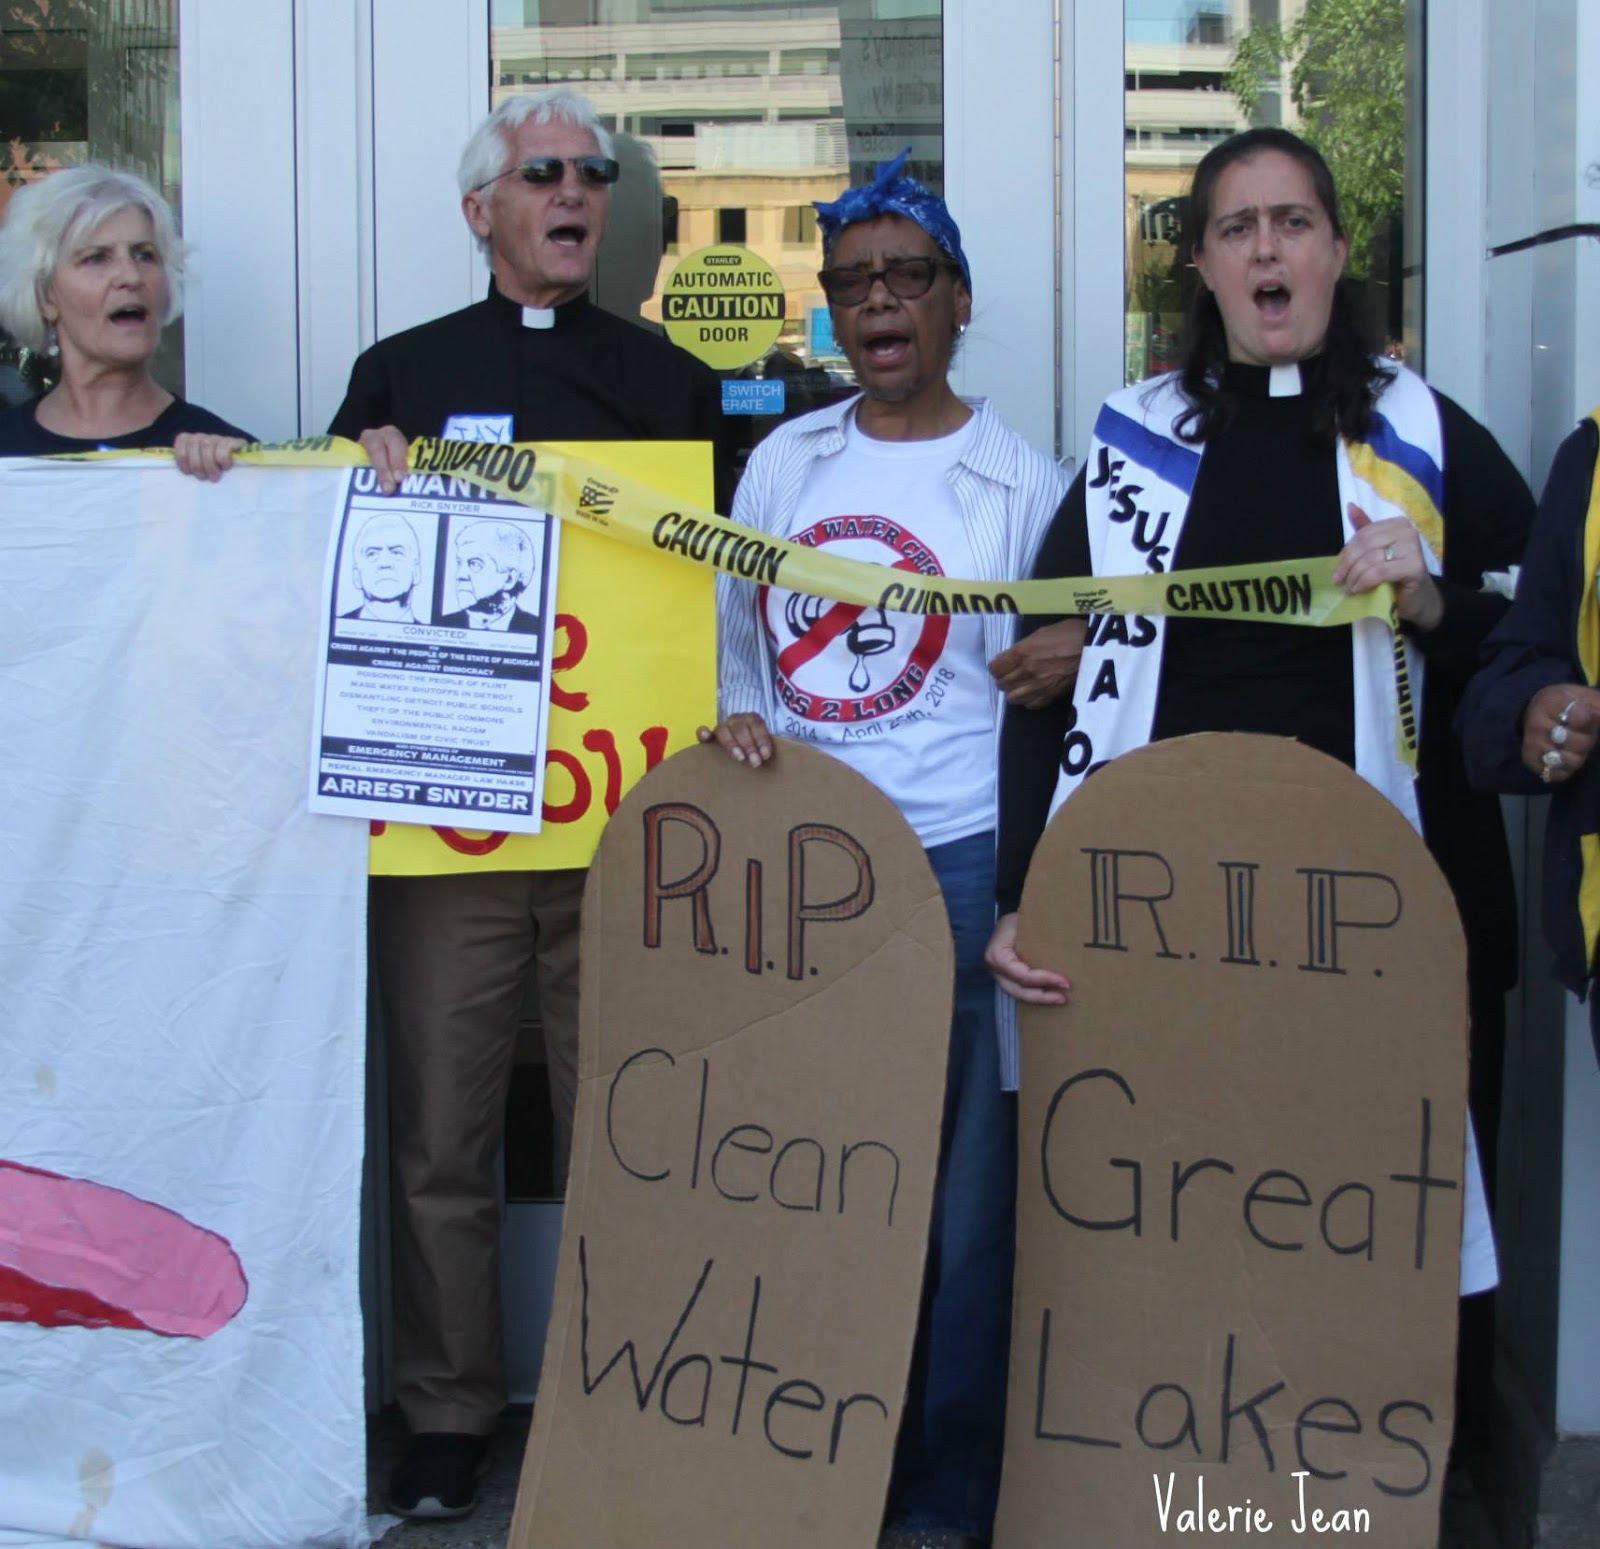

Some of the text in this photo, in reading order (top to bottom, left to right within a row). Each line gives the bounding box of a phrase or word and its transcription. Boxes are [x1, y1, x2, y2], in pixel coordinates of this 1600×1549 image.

[705, 257, 740, 265] STANLEY
[672, 272, 773, 287] AUTOMATIC
[668, 296, 779, 318] CAUTION
[700, 327, 749, 342] DOOR
[728, 385, 781, 396] SWITCH
[722, 399, 765, 411] ERATE
[415, 438, 537, 492] CUIDADO
[410, 500, 480, 512] RICK SNYDER
[653, 512, 789, 584] CAUTION
[822, 518, 899, 545] WATER
[901, 540, 941, 577] CRIS
[1166, 573, 1312, 616] CAUTION
[403, 626, 467, 639] CONVICTED!
[359, 645, 391, 654] AGAINST
[408, 649, 437, 658] PEOPLE
[466, 655, 490, 663] STATE
[503, 658, 540, 666] MICHIGAN
[404, 662, 441, 671] AGAINST
[443, 665, 494, 675] DEMOCRACY
[357, 671, 405, 680] POISONING
[429, 677, 463, 686] PEOPLE
[481, 681, 507, 689] FLINT
[821, 700, 842, 719] 2
[853, 662, 925, 719] LONG
[1088, 659, 1119, 702] A
[339, 691, 523, 713] DISMANTLING DETROIT PUBLIC SCHOOLS
[412, 686, 459, 696] SHUTOFFS
[473, 691, 513, 701] DETROIT
[357, 705, 385, 713] THEFT
[403, 709, 421, 717] THE
[423, 711, 457, 719] PUBLIC
[457, 714, 504, 724] COMMONS
[785, 716, 818, 742] 2014
[842, 723, 883, 743] April
[926, 667, 956, 707] 2018
[372, 718, 486, 734] ENVIRONMENTAL RACISM
[366, 729, 418, 740] VANDALISM
[434, 735, 458, 743] CIVIC
[461, 738, 491, 747] TRUST
[347, 745, 418, 760] EMERGENCY
[421, 752, 507, 767] MANAGEMENT
[328, 762, 364, 772] REPEAL
[366, 766, 421, 777] EMERGENCY
[425, 771, 471, 782] MANAGER
[473, 775, 493, 784] LAW
[321, 777, 529, 811] ARREST SNYDER
[643, 802, 875, 980] R.I.P.
[1081, 848, 1402, 978] R.I.P.
[607, 1047, 900, 1226] Clean
[1041, 1068, 1457, 1270] Great
[580, 1235, 888, 1464] Water
[1035, 1307, 1434, 1497] Lakes
